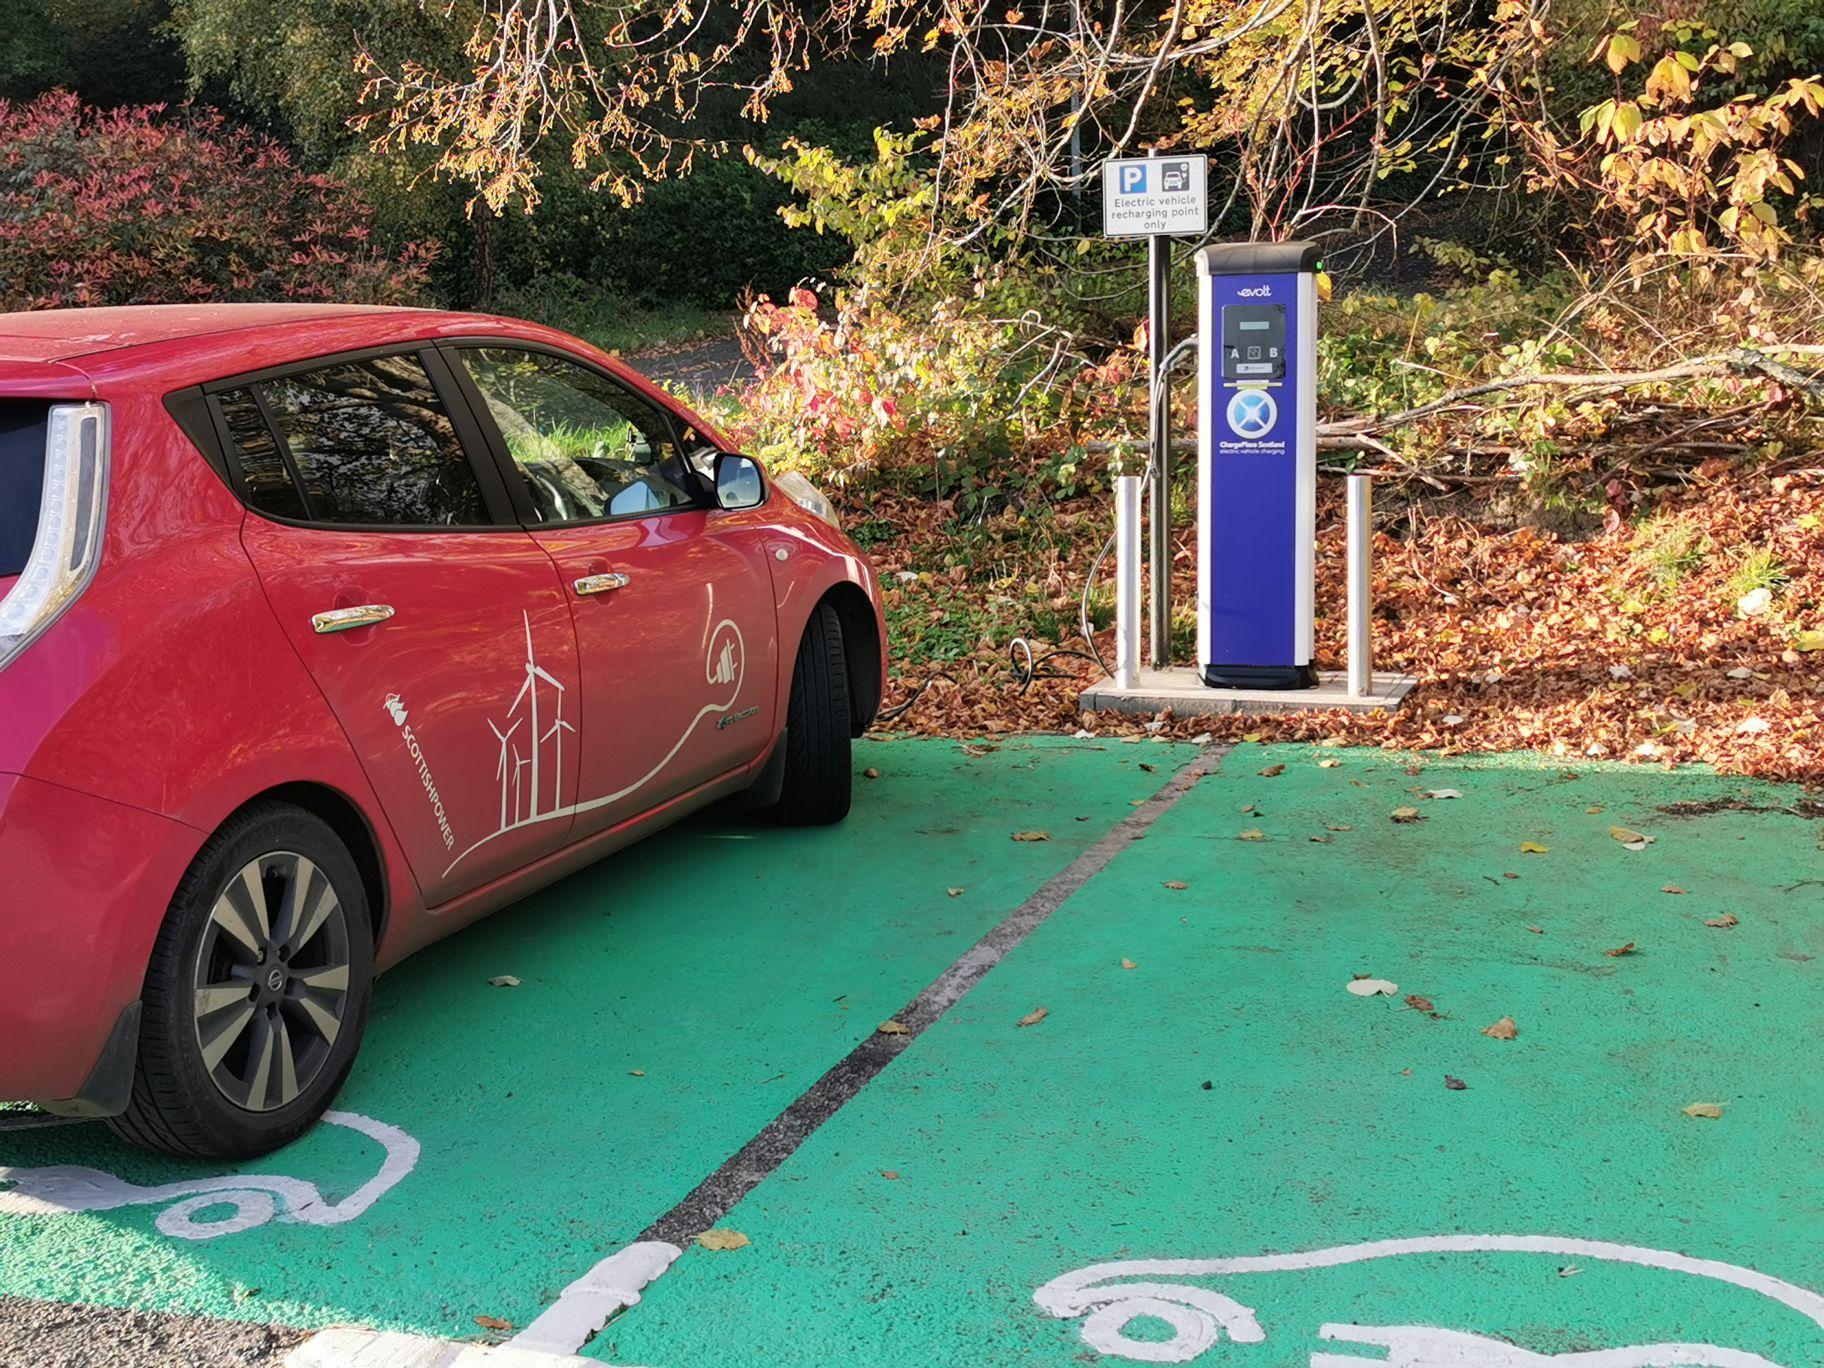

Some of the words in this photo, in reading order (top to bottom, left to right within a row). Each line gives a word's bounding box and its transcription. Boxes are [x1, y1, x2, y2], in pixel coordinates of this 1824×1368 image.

[1124, 167, 1142, 192] P
[1114, 198, 1155, 208] Electric
[1158, 195, 1197, 206] vehicle
[1111, 208, 1168, 220] recharging
[1171, 206, 1199, 218] point
[1143, 219, 1167, 231] only
[1237, 285, 1272, 297] evolt
[1230, 347, 1240, 359] A
[1269, 347, 1278, 358] B
[401, 725, 455, 851] SCOTTISHPOWER
